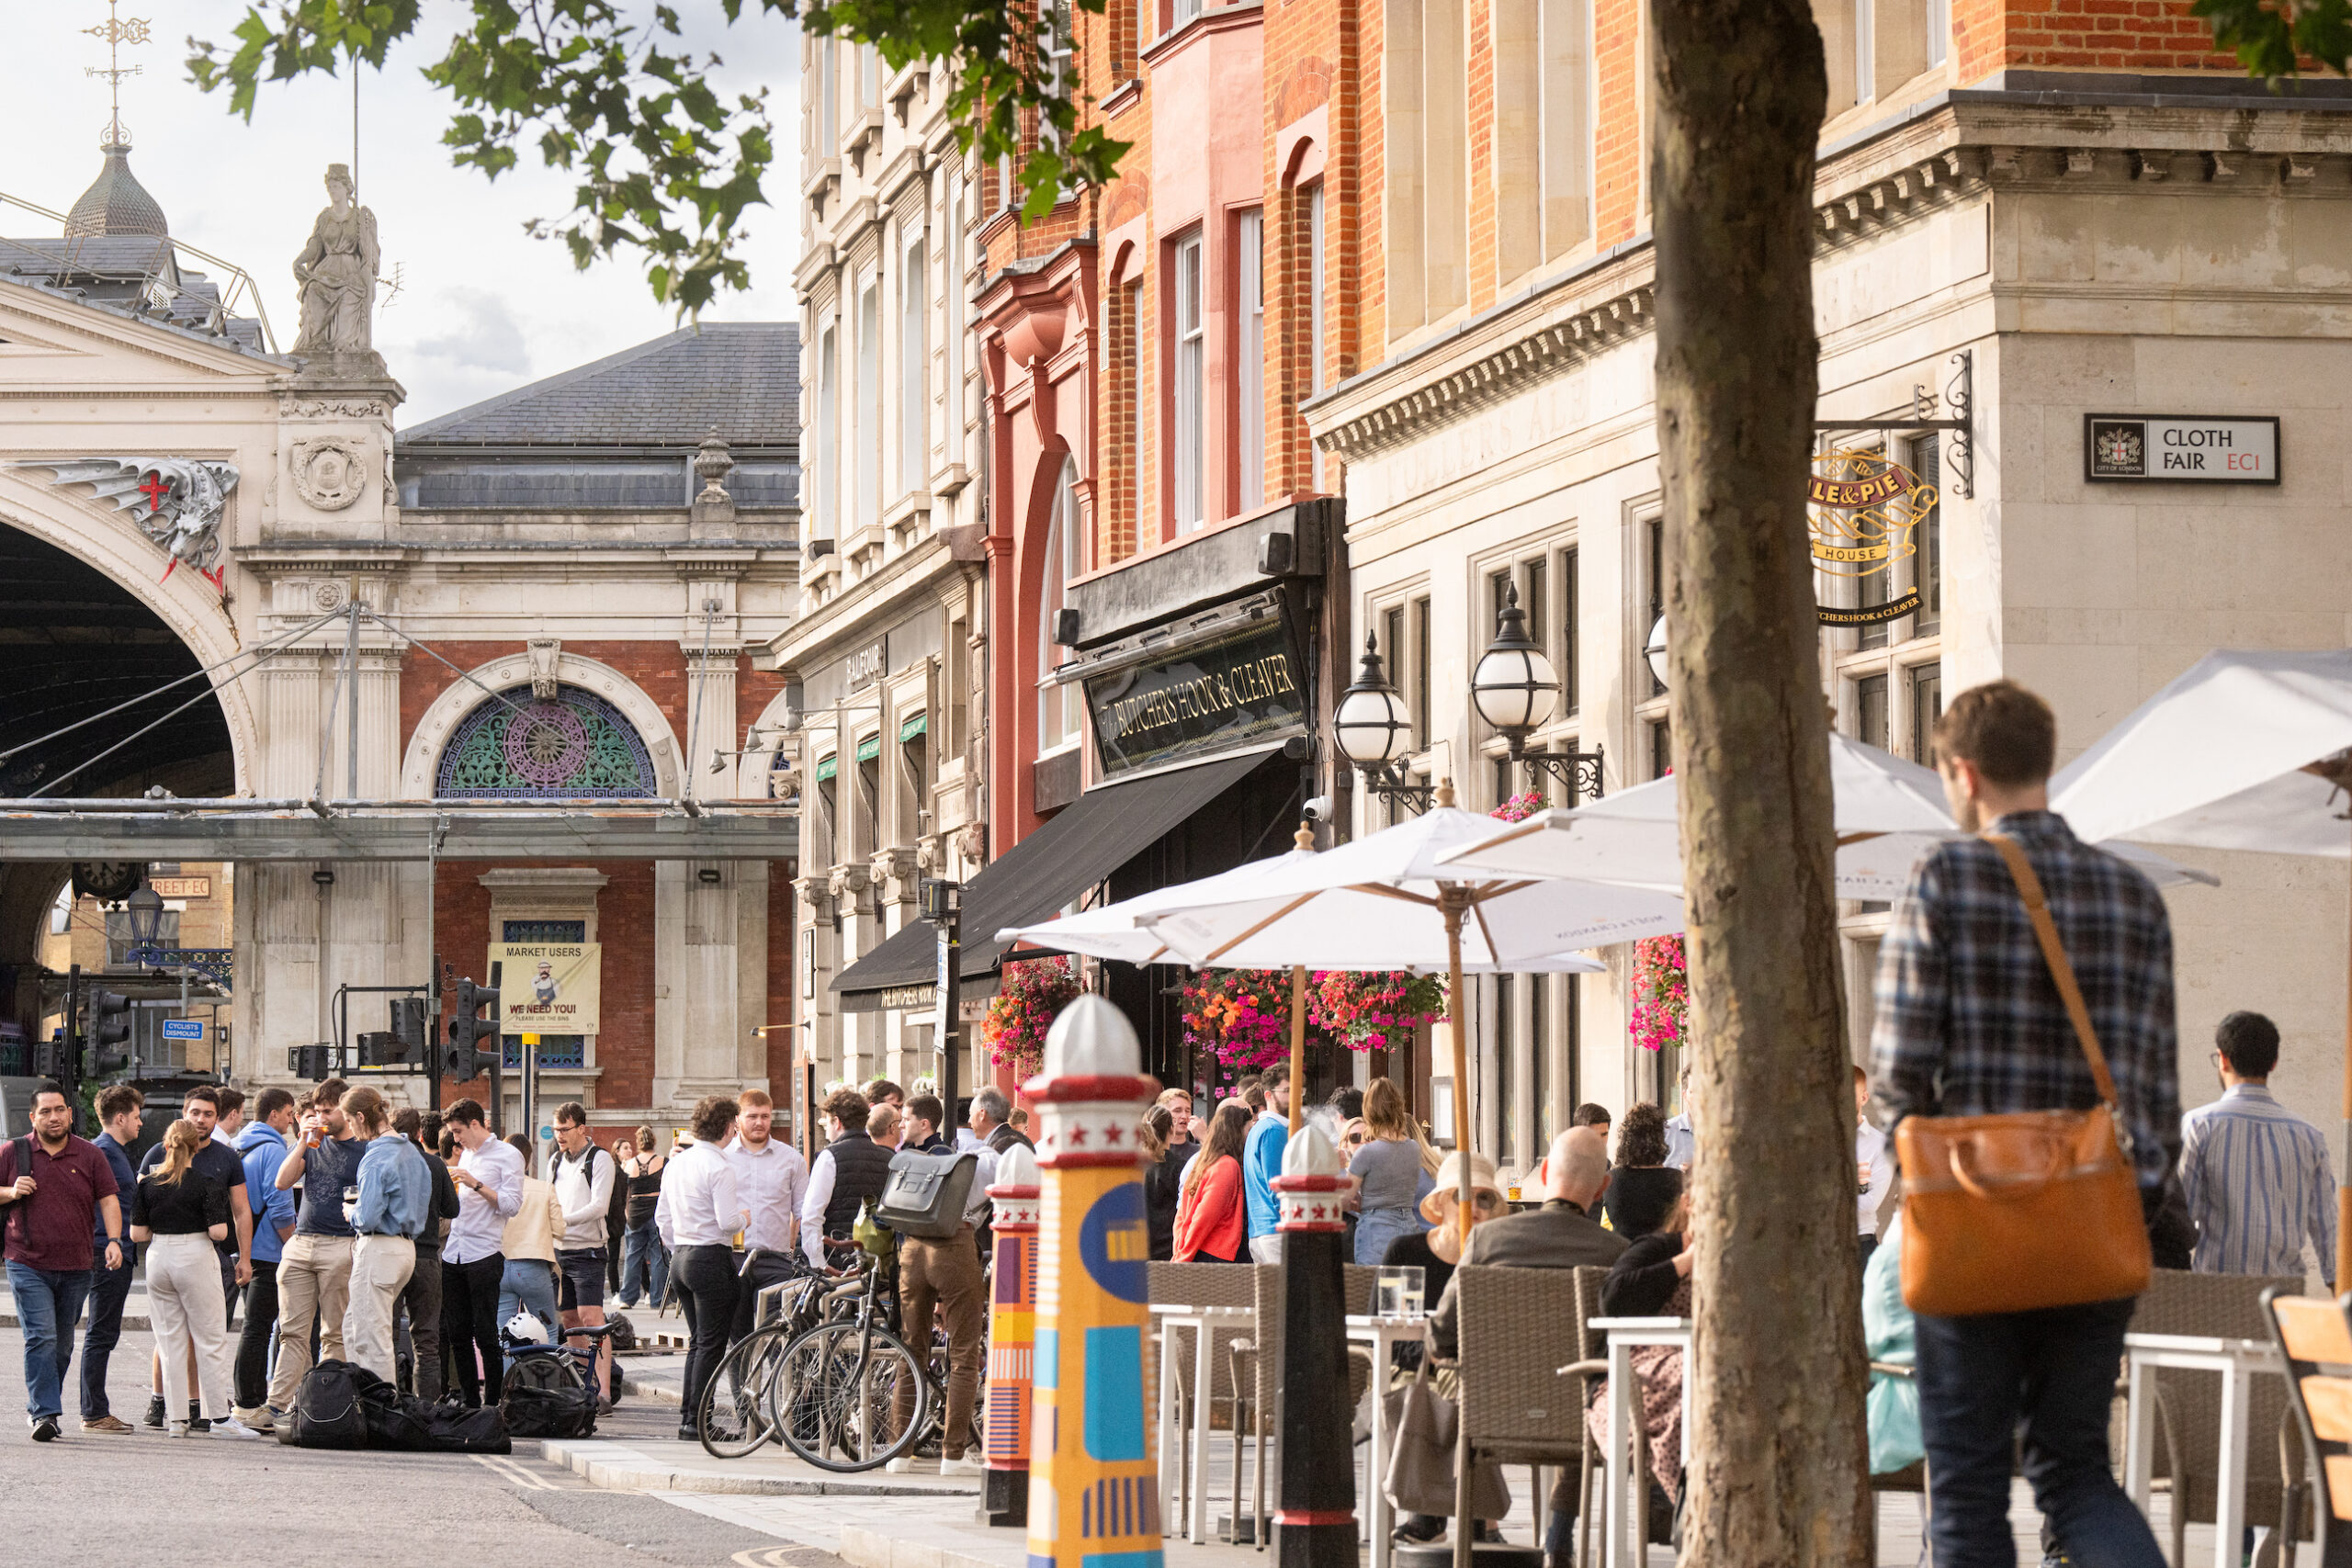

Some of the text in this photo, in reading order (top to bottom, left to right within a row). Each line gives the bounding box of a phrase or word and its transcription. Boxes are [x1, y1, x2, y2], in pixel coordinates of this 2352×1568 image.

[2163, 429, 2233, 447] CLOTH
[2163, 452, 2260, 470] FAIR EC1
[1826, 548, 1877, 560] HOUSE
[1849, 612, 1876, 623] HOOK
[1883, 597, 1919, 618] CLEAVER
[846, 644, 879, 685] BALFOUR
[1114, 687, 1178, 738] BUTCHERS
[1174, 674, 1221, 720] HOOK
[1216, 672, 1233, 707] &
[1230, 653, 1295, 705] CLEAVER
[506, 947, 582, 957] MARKET USERS
[881, 988, 892, 1008] THE
[510, 1004, 577, 1014] WE NEED YOU!
[168, 1022, 199, 1031] CYCLISTS
